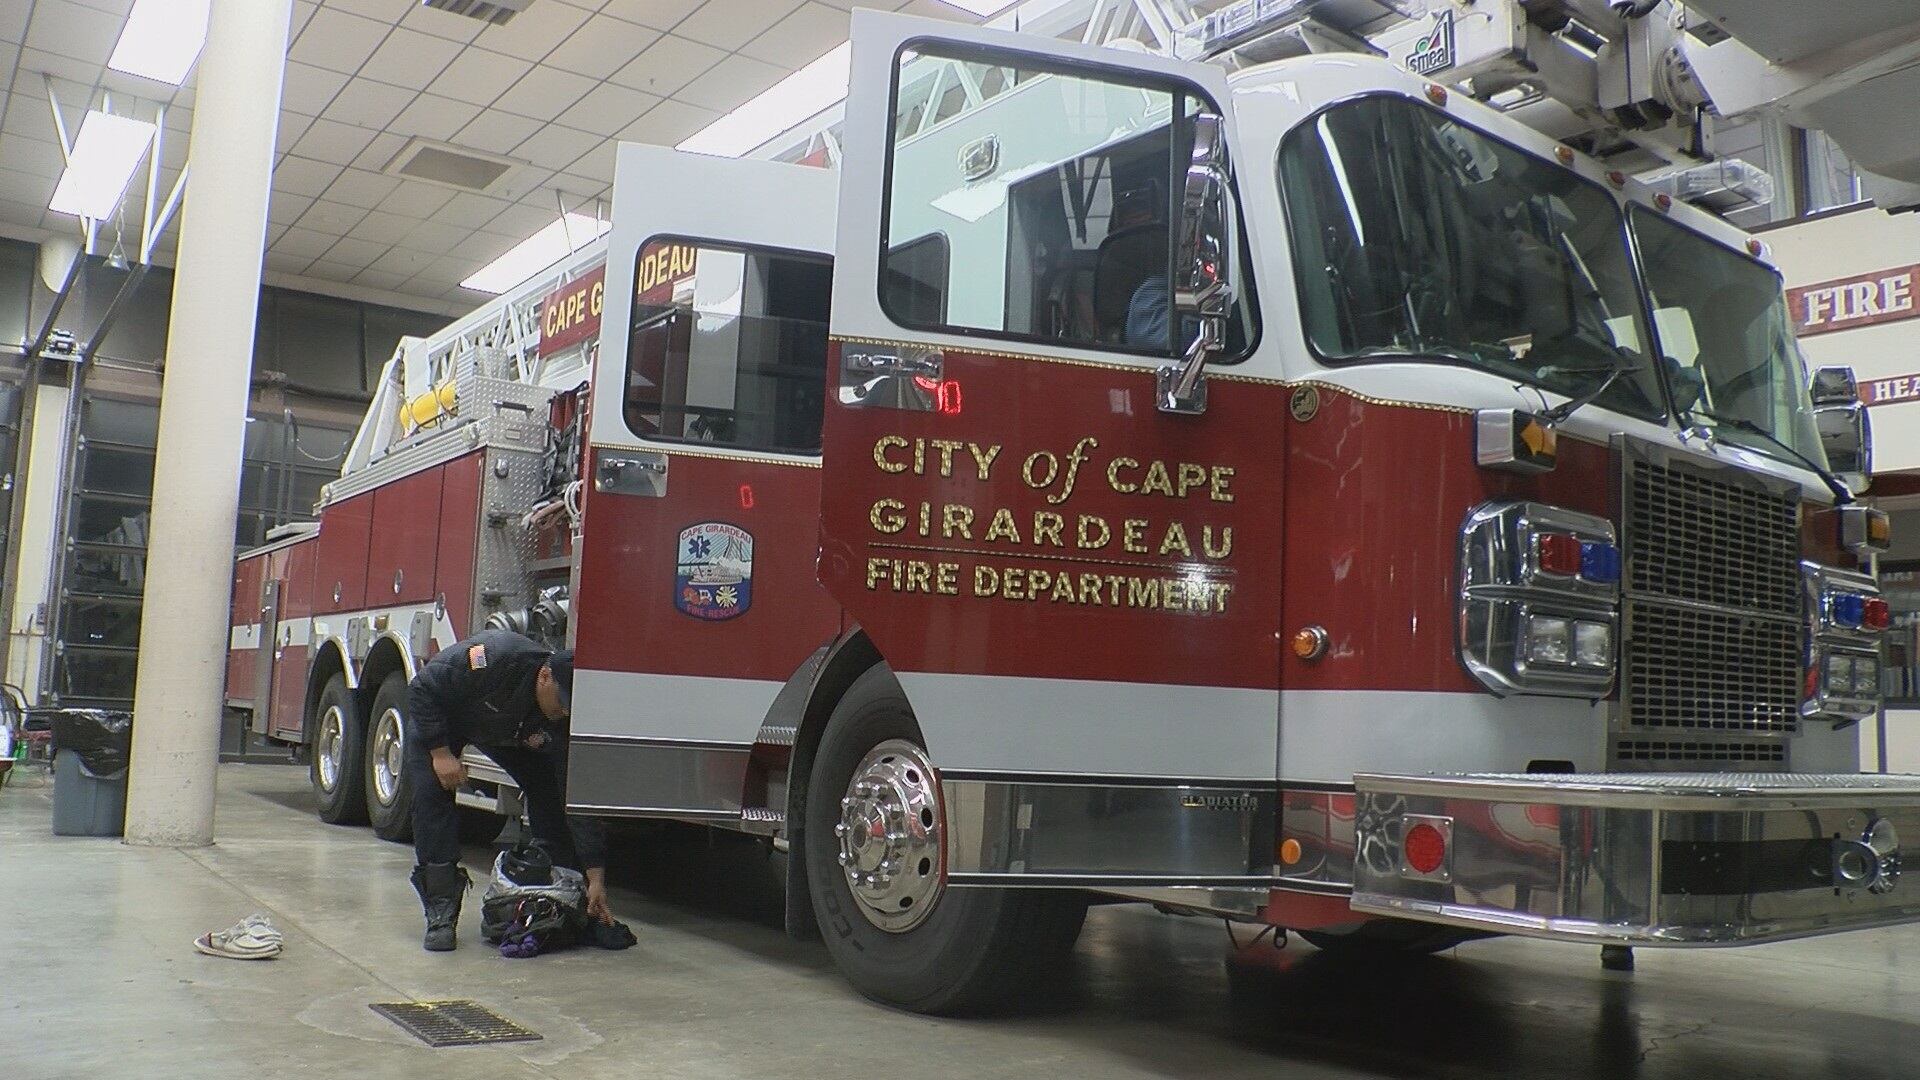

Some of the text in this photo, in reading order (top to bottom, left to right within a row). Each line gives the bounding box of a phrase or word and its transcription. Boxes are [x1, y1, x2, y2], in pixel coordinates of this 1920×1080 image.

[546, 288, 586, 338] CAPE
[1804, 273, 1913, 326] FIRE
[873, 435, 1235, 504] CITY of CAPE
[681, 524, 751, 545] CAPE GIRARDEAU
[869, 498, 1233, 560] GIRARDEAU
[866, 557, 1232, 613] FIRE DEPARTMENT
[1181, 795, 1259, 809] GLADIATOR
